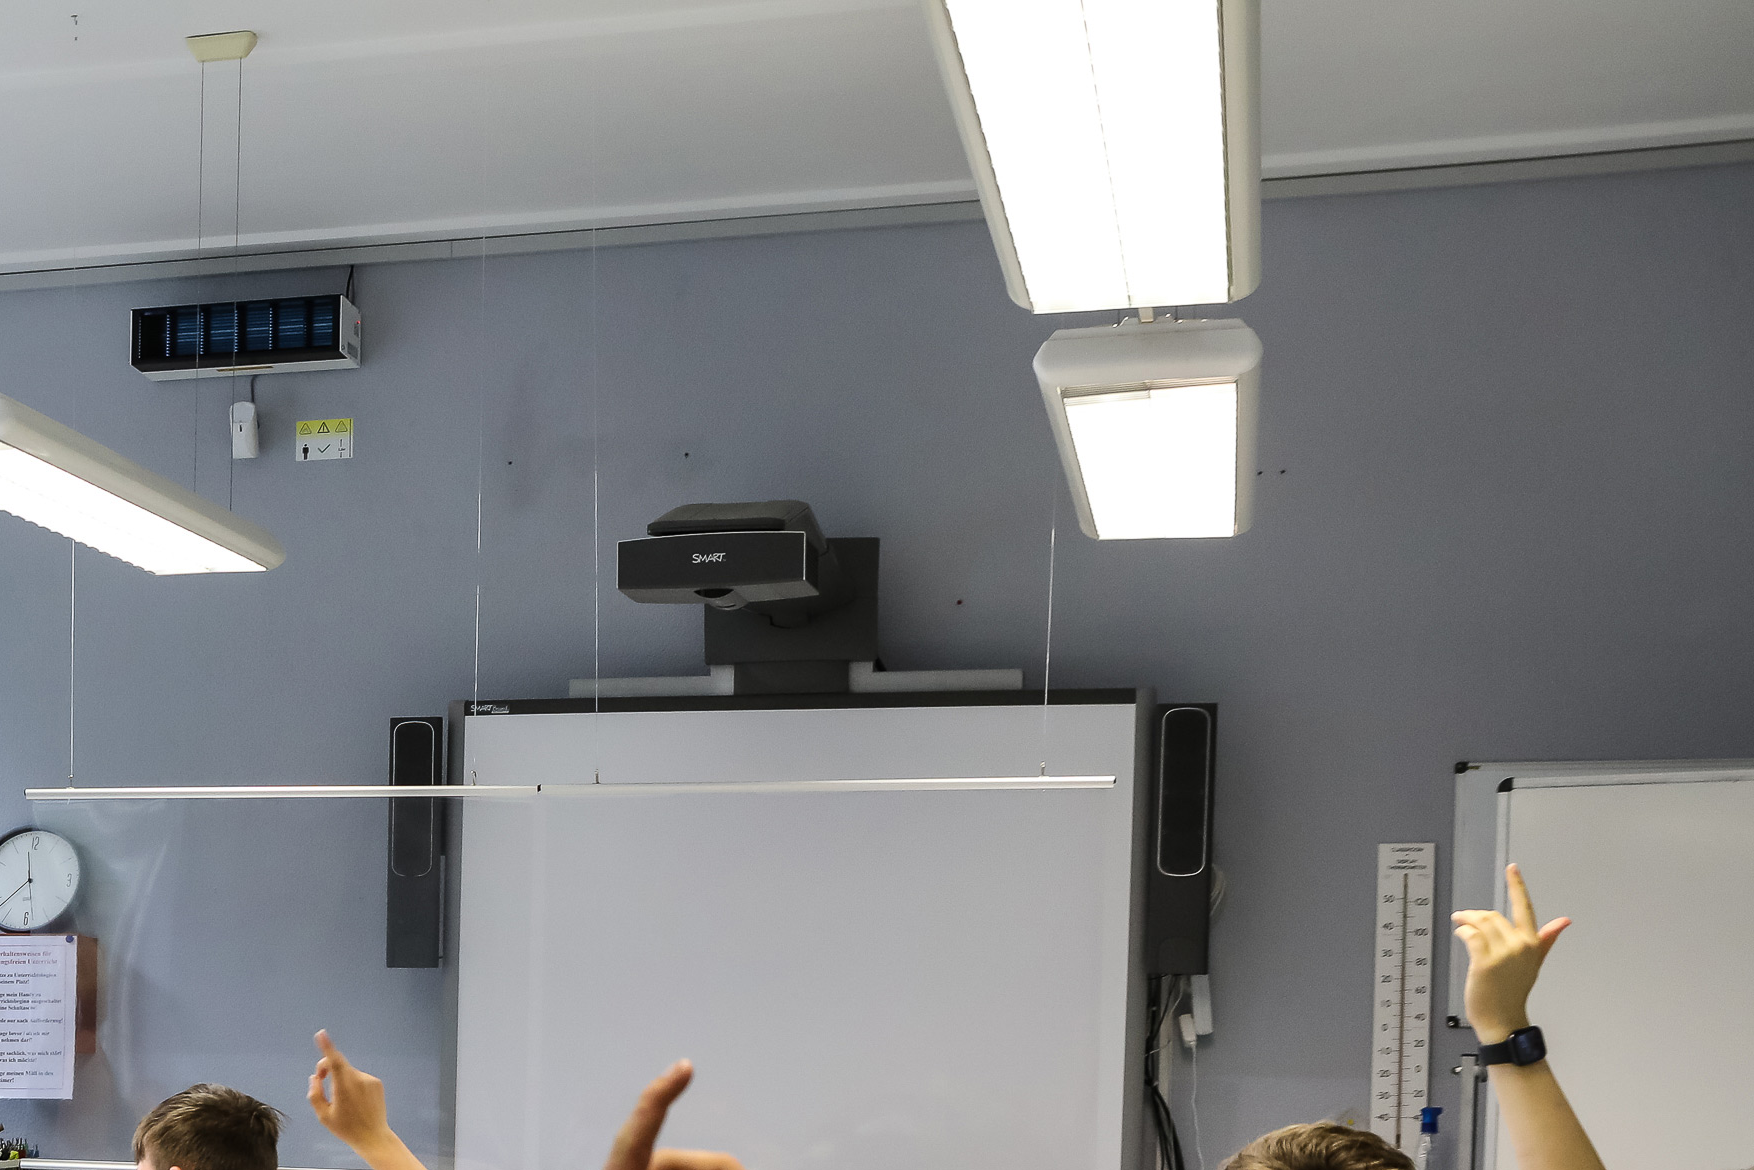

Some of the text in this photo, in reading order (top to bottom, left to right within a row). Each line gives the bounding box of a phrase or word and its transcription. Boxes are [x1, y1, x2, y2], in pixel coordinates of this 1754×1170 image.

[692, 552, 726, 563] SMART
[470, 704, 492, 712] SMART
[32, 836, 40, 850] 12
[66, 874, 72, 888] 3
[1382, 894, 1395, 903] 50
[24, 912, 29, 926] 6
[1382, 922, 1394, 930] 40
[1382, 948, 1394, 957] 30
[1416, 958, 1427, 966] 80
[1381, 974, 1392, 983] 20
[1415, 986, 1427, 994] 60
[1414, 1013, 1426, 1021] 40
[1381, 1023, 1388, 1031] 0
[1413, 1039, 1425, 1048] 20
[1414, 1065, 1423, 1073] 0
